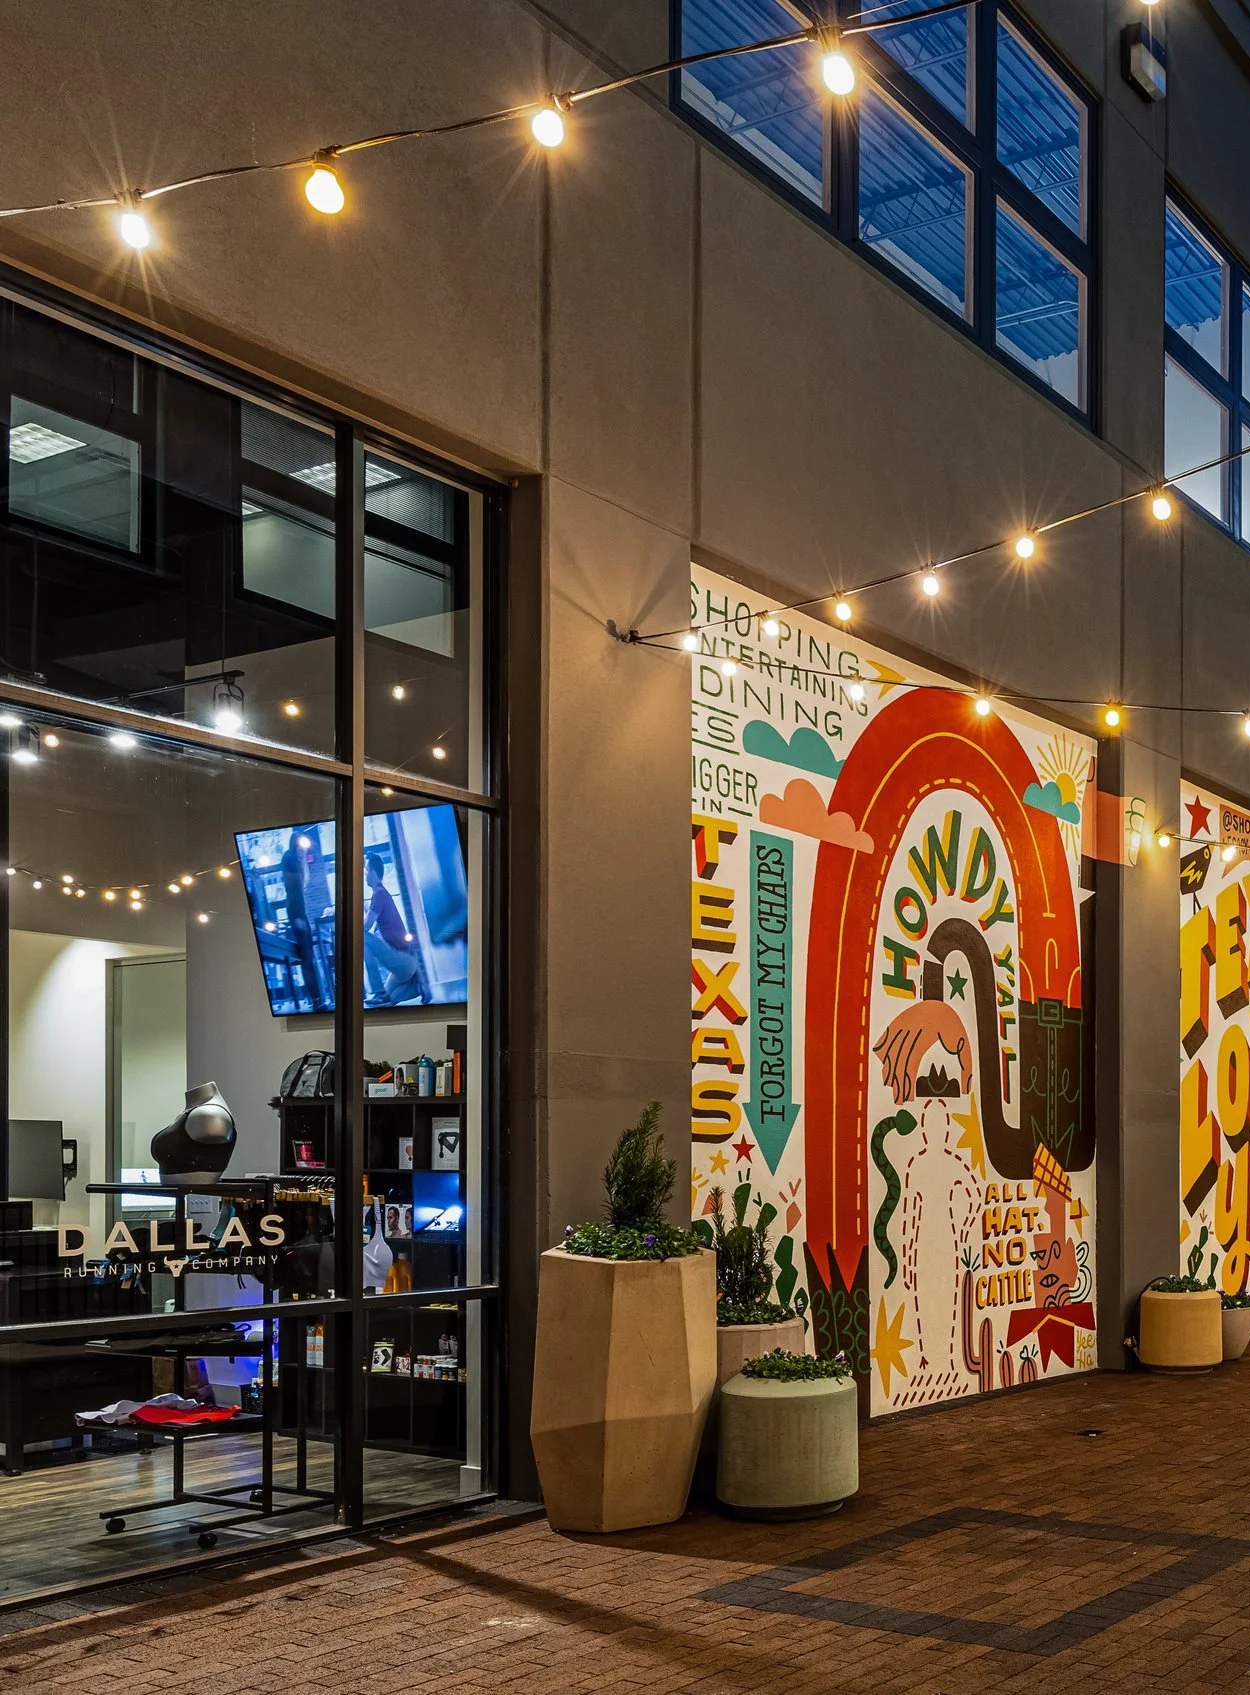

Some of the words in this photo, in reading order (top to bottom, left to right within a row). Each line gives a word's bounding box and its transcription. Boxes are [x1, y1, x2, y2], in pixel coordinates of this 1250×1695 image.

[700, 632, 868, 717] NTERTAINING
[699, 665, 843, 741] DINING
[692, 755, 758, 806] IGGER
[701, 797, 722, 814] IN
[757, 844, 788, 935] CHAPS
[882, 809, 1014, 1000] HOWDY
[692, 814, 748, 1144] TEXAS
[757, 934, 786, 989] MY
[993, 943, 1016, 1105] Y'ALL
[758, 998, 786, 1125] FORGOT
[984, 1182, 1028, 1206] ALL
[58, 1214, 286, 1258] DALLAS
[982, 1236, 1027, 1270] NO
[63, 1262, 157, 1279] RUNNING
[191, 1254, 280, 1270] COMPANY
[976, 1268, 1033, 1310] CATTLE
